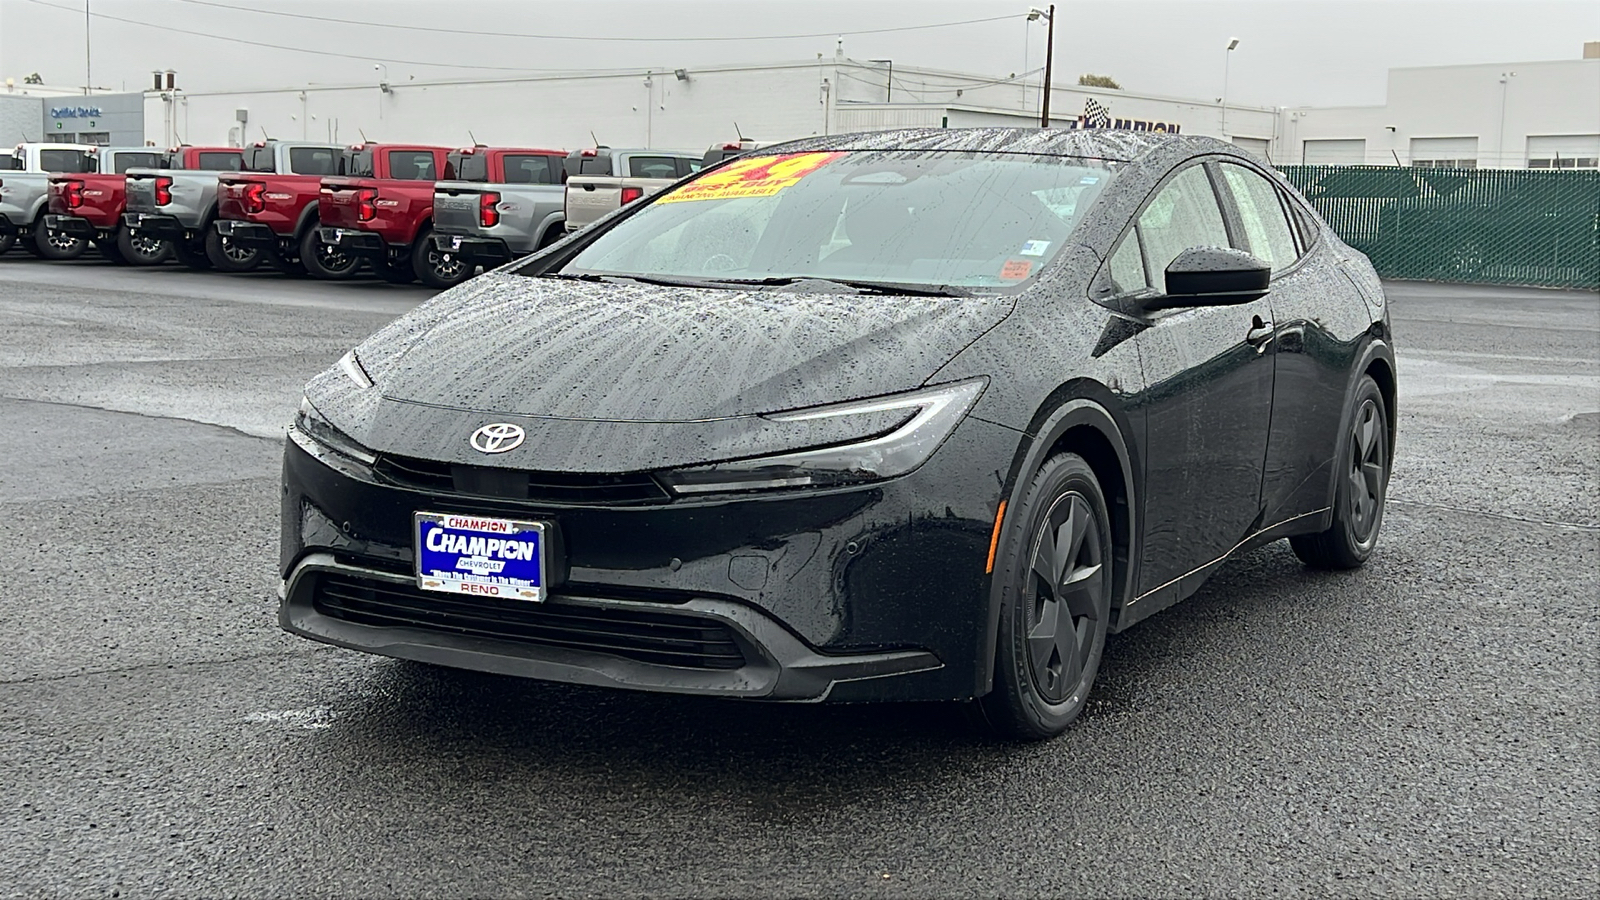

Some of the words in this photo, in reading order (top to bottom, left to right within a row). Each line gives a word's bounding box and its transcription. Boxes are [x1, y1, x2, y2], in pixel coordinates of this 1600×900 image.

[681, 181, 740, 194] BEST
[740, 178, 789, 188] BUY
[717, 187, 776, 198] AVAILABLE
[449, 518, 507, 532] CHAMPION
[426, 527, 535, 561] CHAMPION
[459, 559, 501, 570] CHEVROLET
[460, 583, 499, 595] RENO
